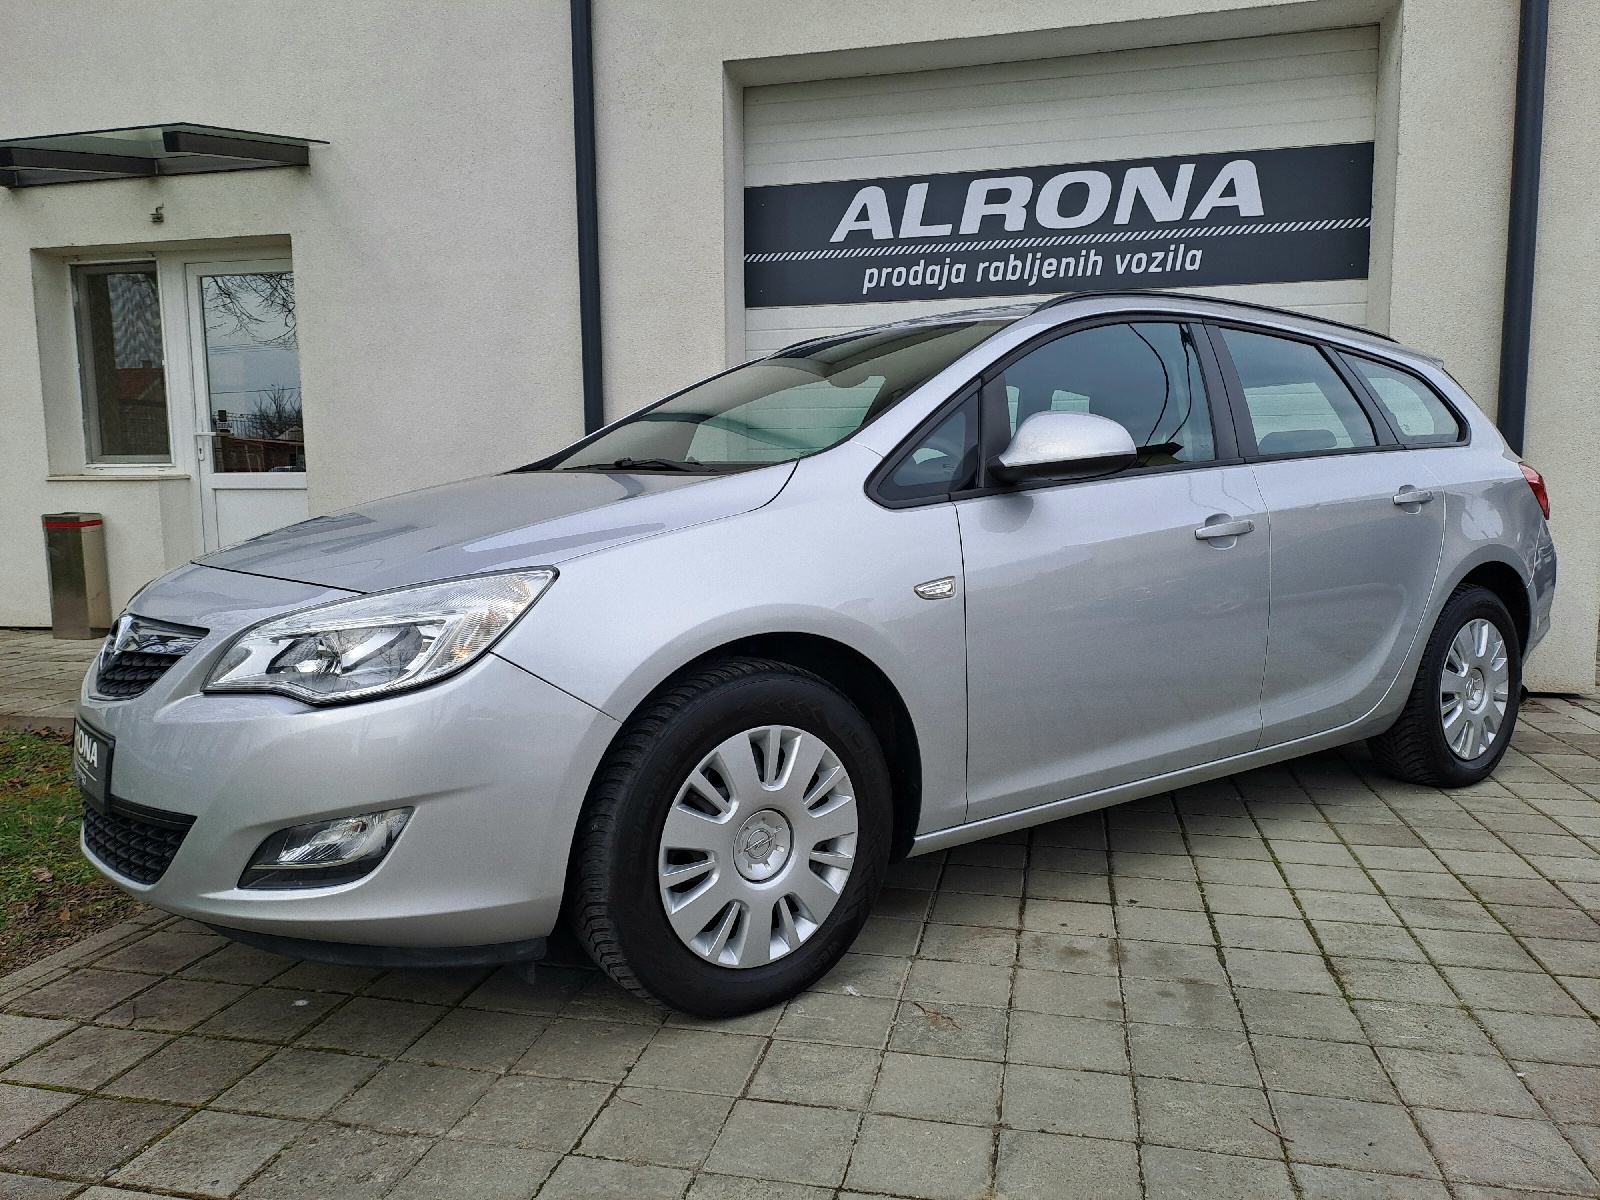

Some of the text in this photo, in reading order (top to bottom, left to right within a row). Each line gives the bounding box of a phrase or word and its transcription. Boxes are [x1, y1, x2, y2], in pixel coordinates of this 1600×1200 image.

[829, 159, 1265, 243] ALRONA
[862, 243, 1204, 295] prodaja rabljenih vozila
